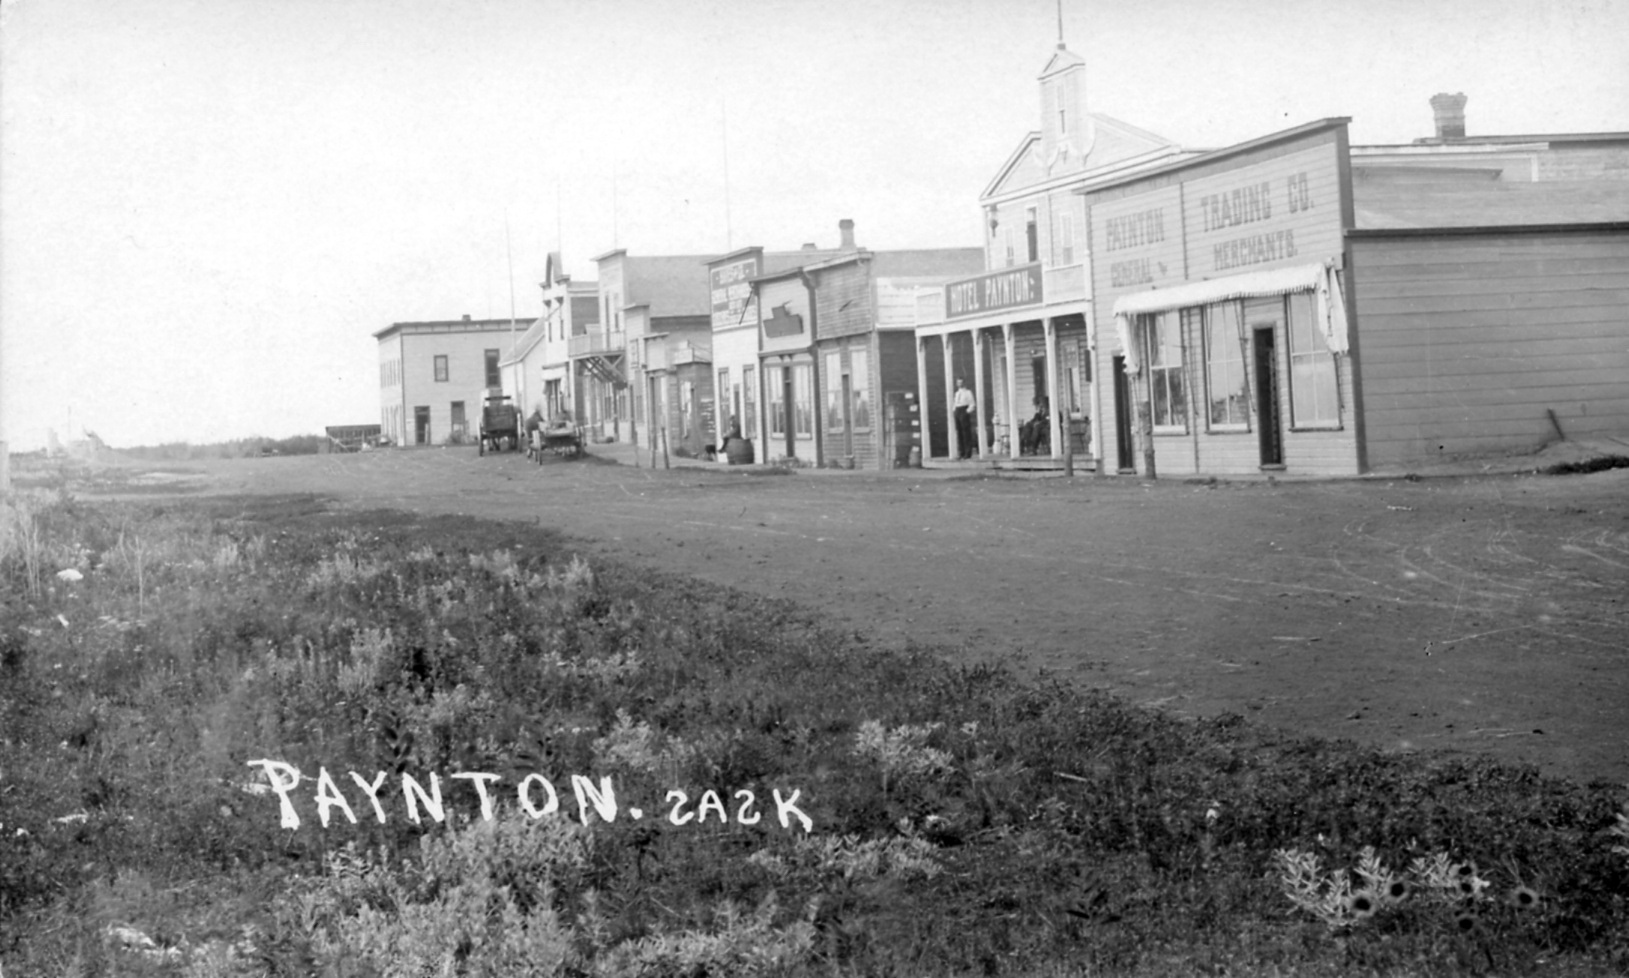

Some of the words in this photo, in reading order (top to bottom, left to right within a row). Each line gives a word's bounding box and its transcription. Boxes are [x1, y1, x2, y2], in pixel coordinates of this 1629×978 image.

[1105, 207, 1165, 252] PAYNTON
[1200, 181, 1271, 232] TRADING
[951, 281, 979, 313] HOTEL
